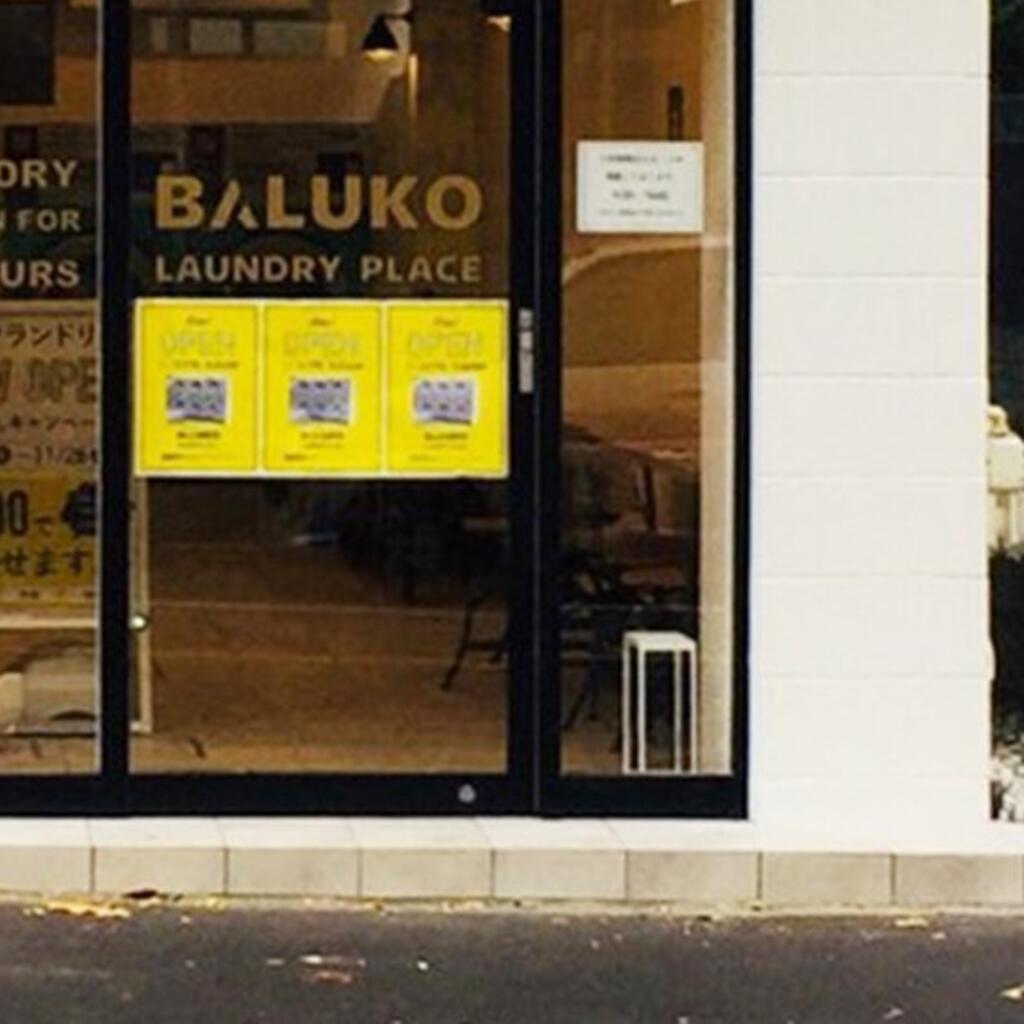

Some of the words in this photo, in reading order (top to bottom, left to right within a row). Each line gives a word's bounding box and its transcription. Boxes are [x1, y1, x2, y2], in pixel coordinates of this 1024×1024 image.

[155, 175, 483, 231] BALUKO
[17, 209, 81, 232] FOR
[155, 255, 342, 283] LAUNDRY
[361, 255, 483, 283] PLACE
